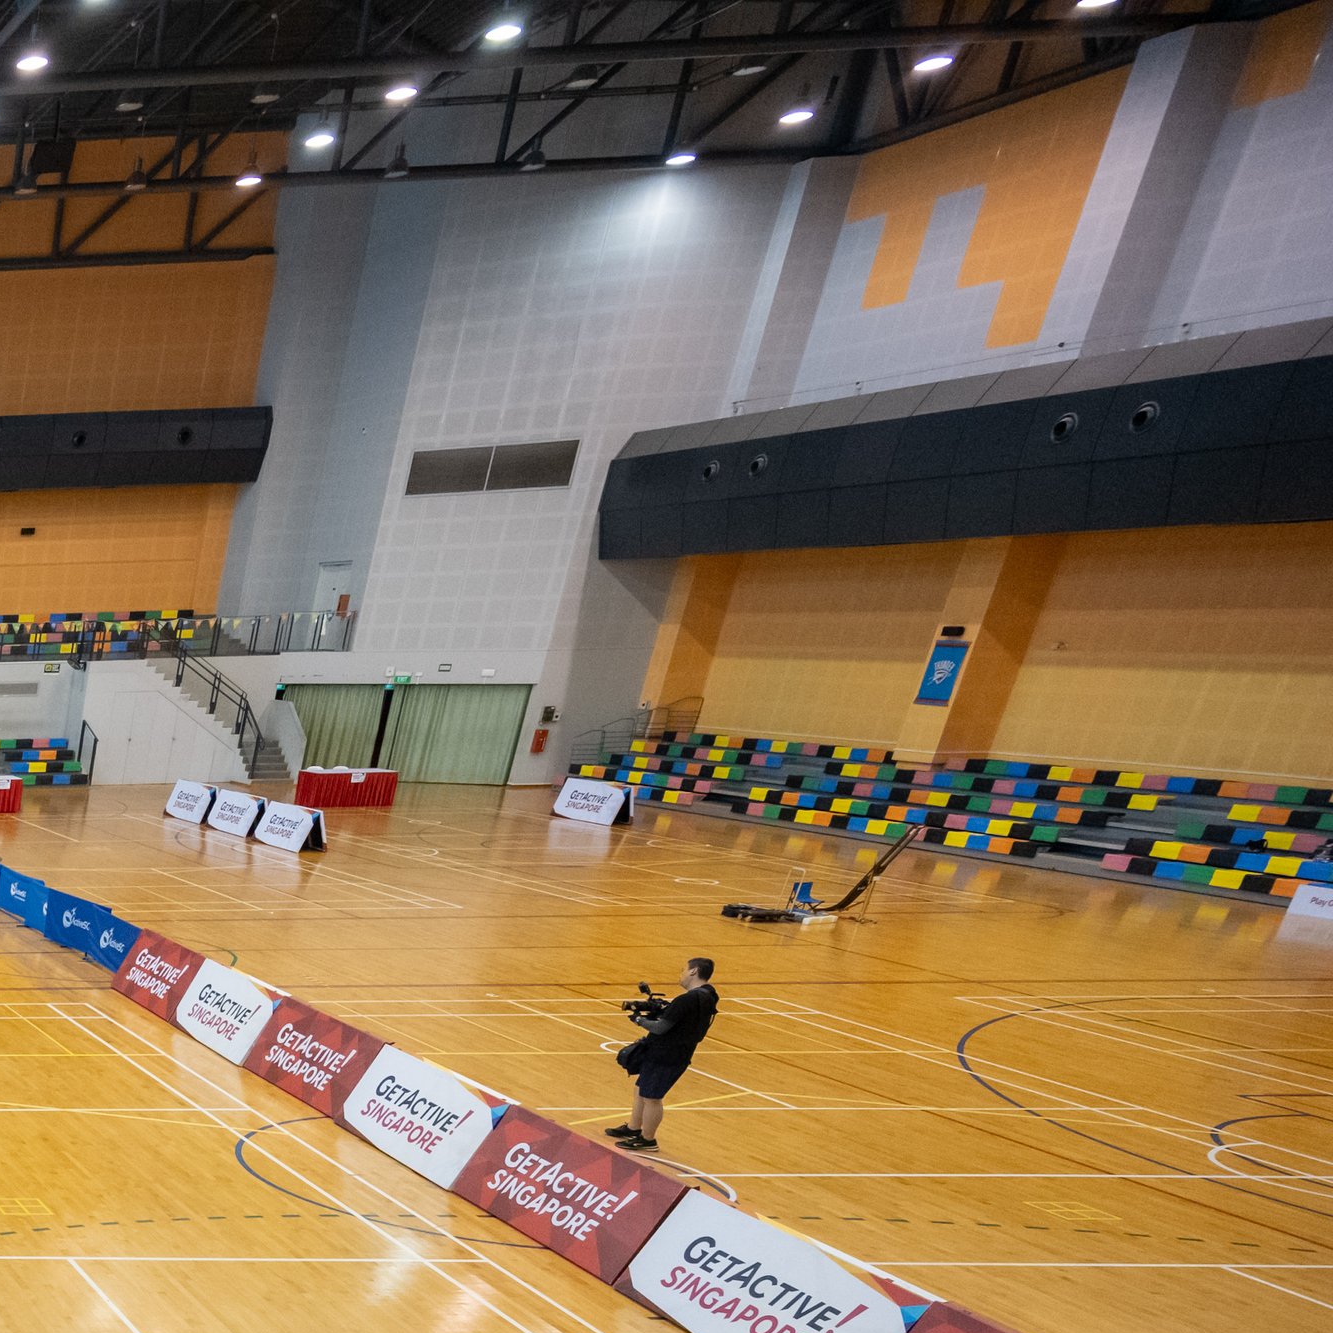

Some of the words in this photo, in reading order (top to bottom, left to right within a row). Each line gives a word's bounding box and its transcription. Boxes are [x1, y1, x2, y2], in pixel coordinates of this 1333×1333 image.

[126, 966, 171, 999] SINGAPORE
[187, 1003, 240, 1042] SINGAPORE
[265, 1045, 333, 1092] SINGAPORE
[360, 1098, 443, 1155] SINGAPORE
[486, 1169, 600, 1241] SINGAPORE
